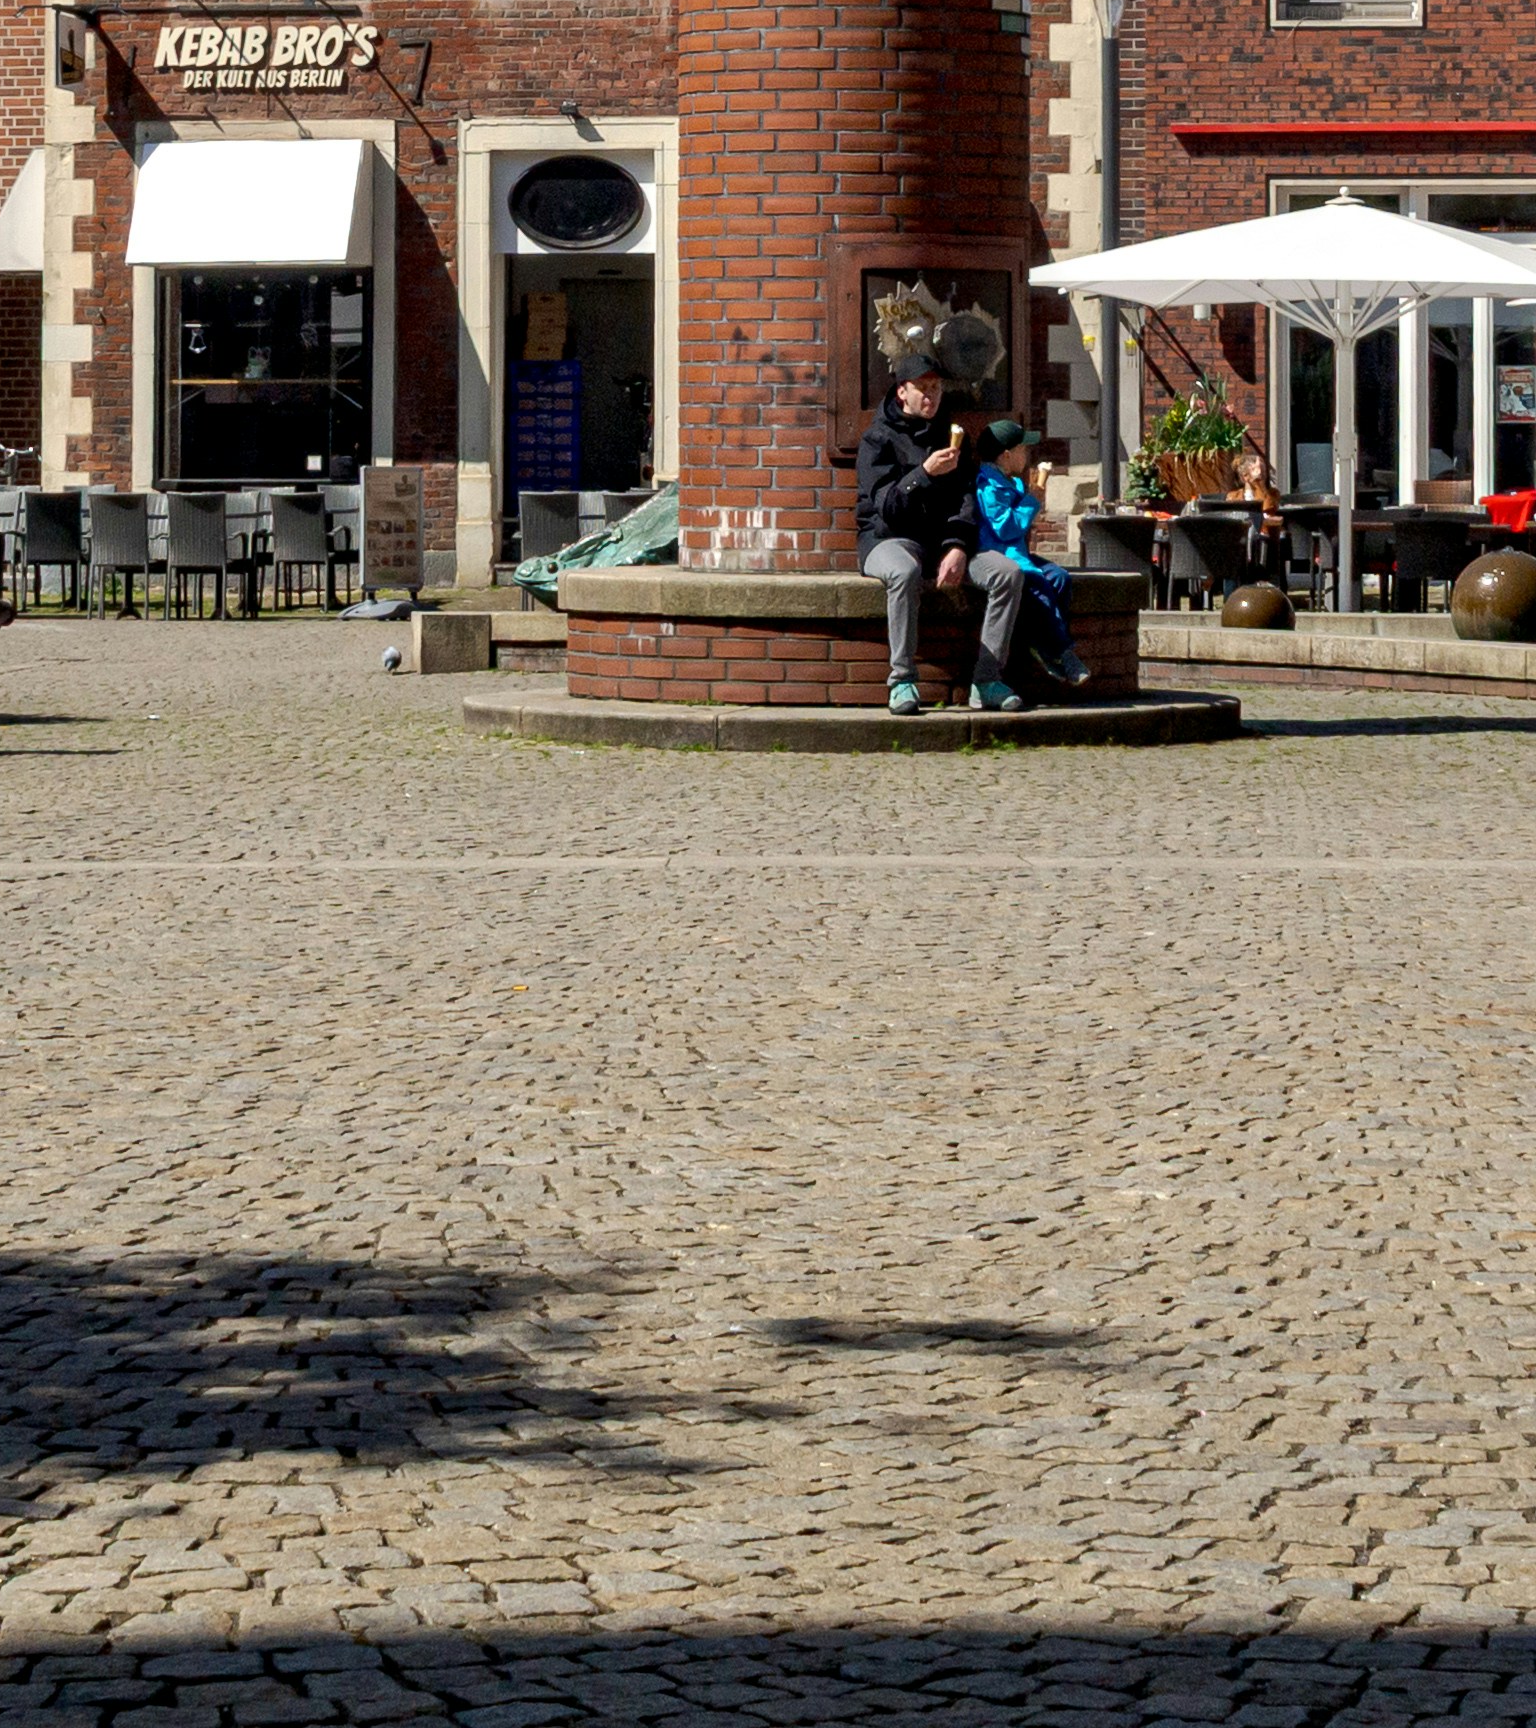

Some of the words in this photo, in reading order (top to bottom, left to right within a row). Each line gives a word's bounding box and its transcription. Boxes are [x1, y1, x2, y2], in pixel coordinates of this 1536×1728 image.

[154, 26, 268, 67] KEBAB
[269, 23, 378, 68] BRO'S
[183, 70, 214, 89] DER
[216, 70, 254, 88] KULT
[255, 69, 286, 88] AUS
[289, 69, 344, 88] BERLIN
